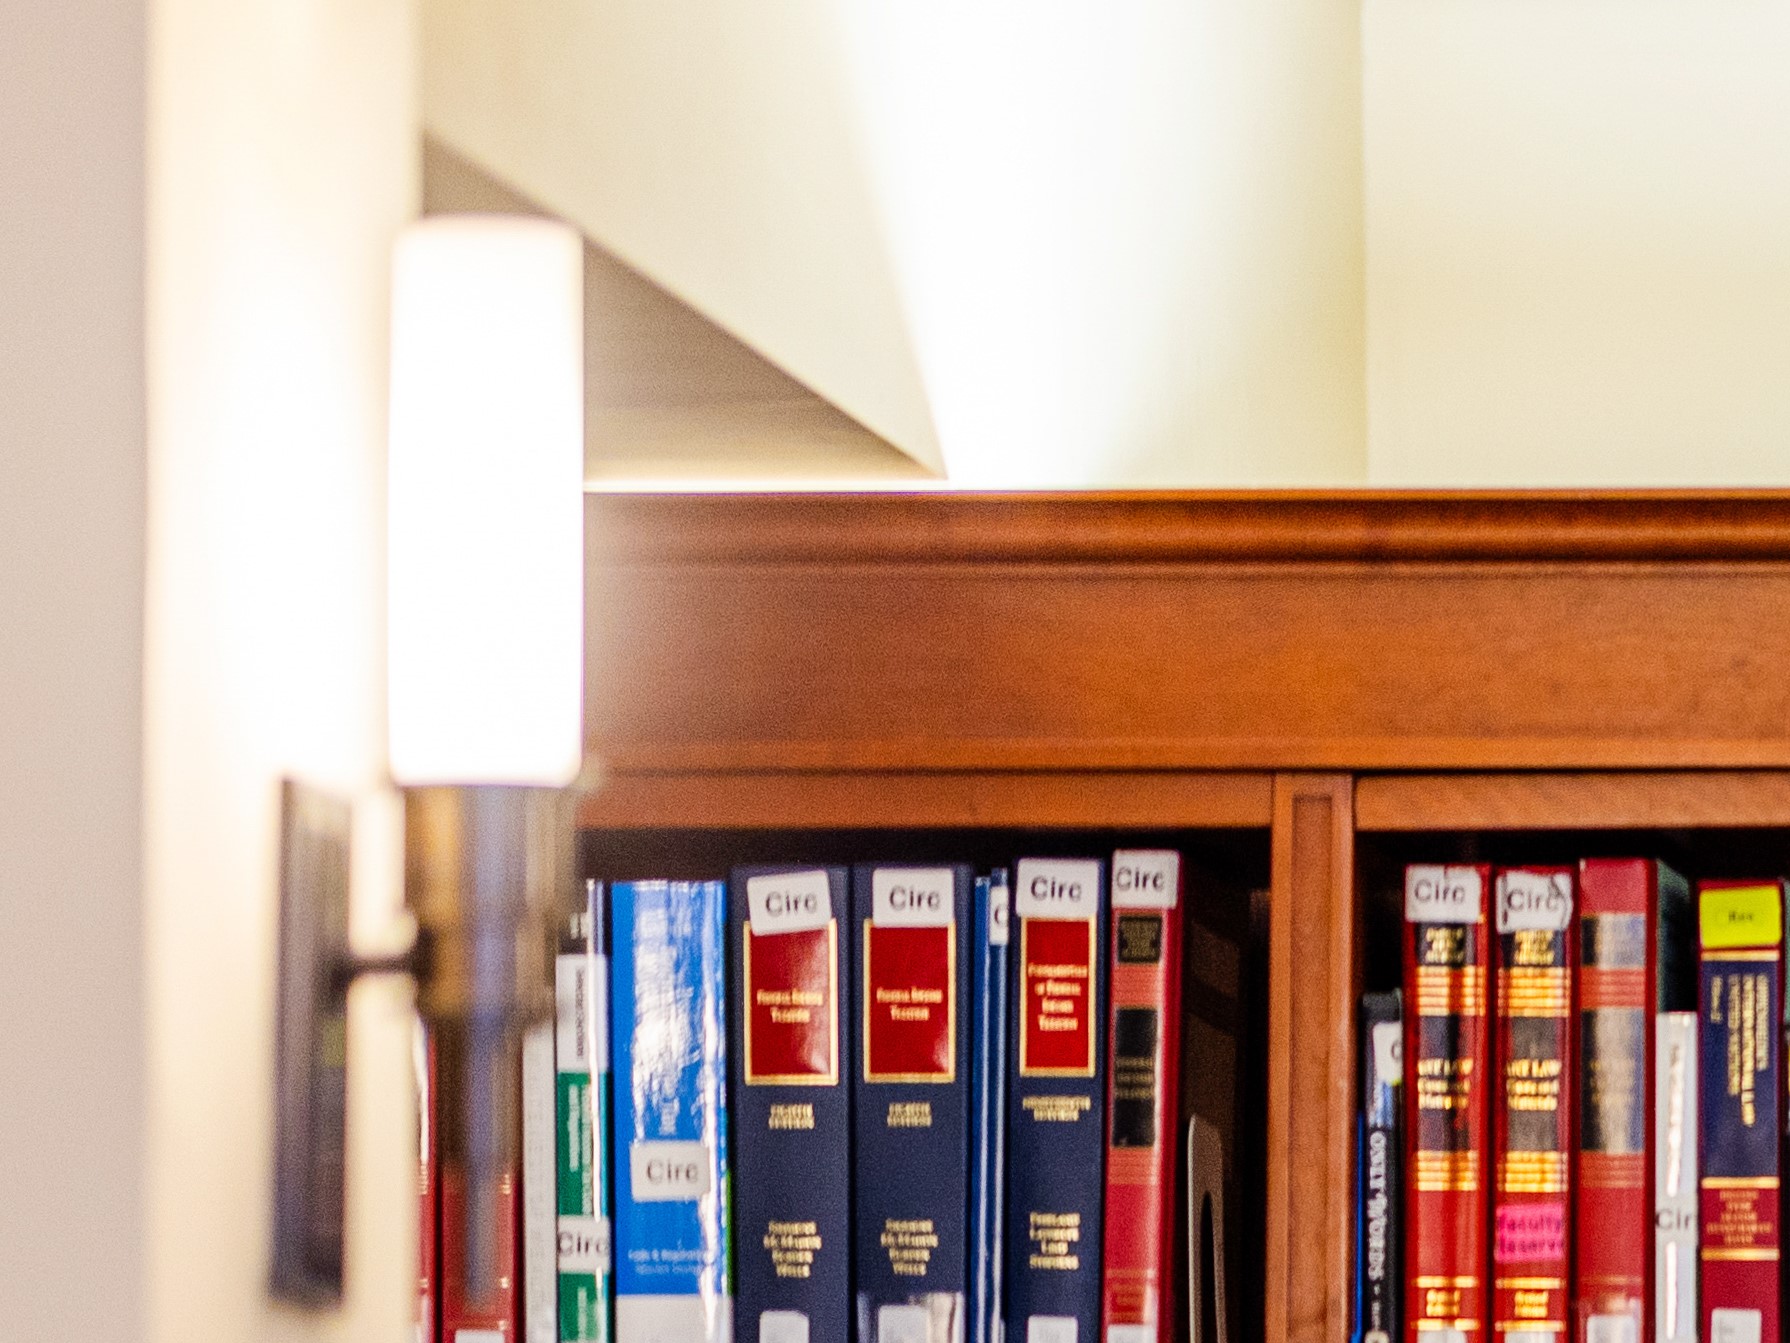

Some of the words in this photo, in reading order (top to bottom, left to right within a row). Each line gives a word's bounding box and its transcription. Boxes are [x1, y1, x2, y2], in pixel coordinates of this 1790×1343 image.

[1030, 875, 1082, 901] Circ
[1116, 865, 1165, 890] Circ
[766, 891, 818, 916] Circ
[889, 886, 941, 911] Circ
[1413, 881, 1466, 904] Circ
[645, 1159, 699, 1183] Circ
